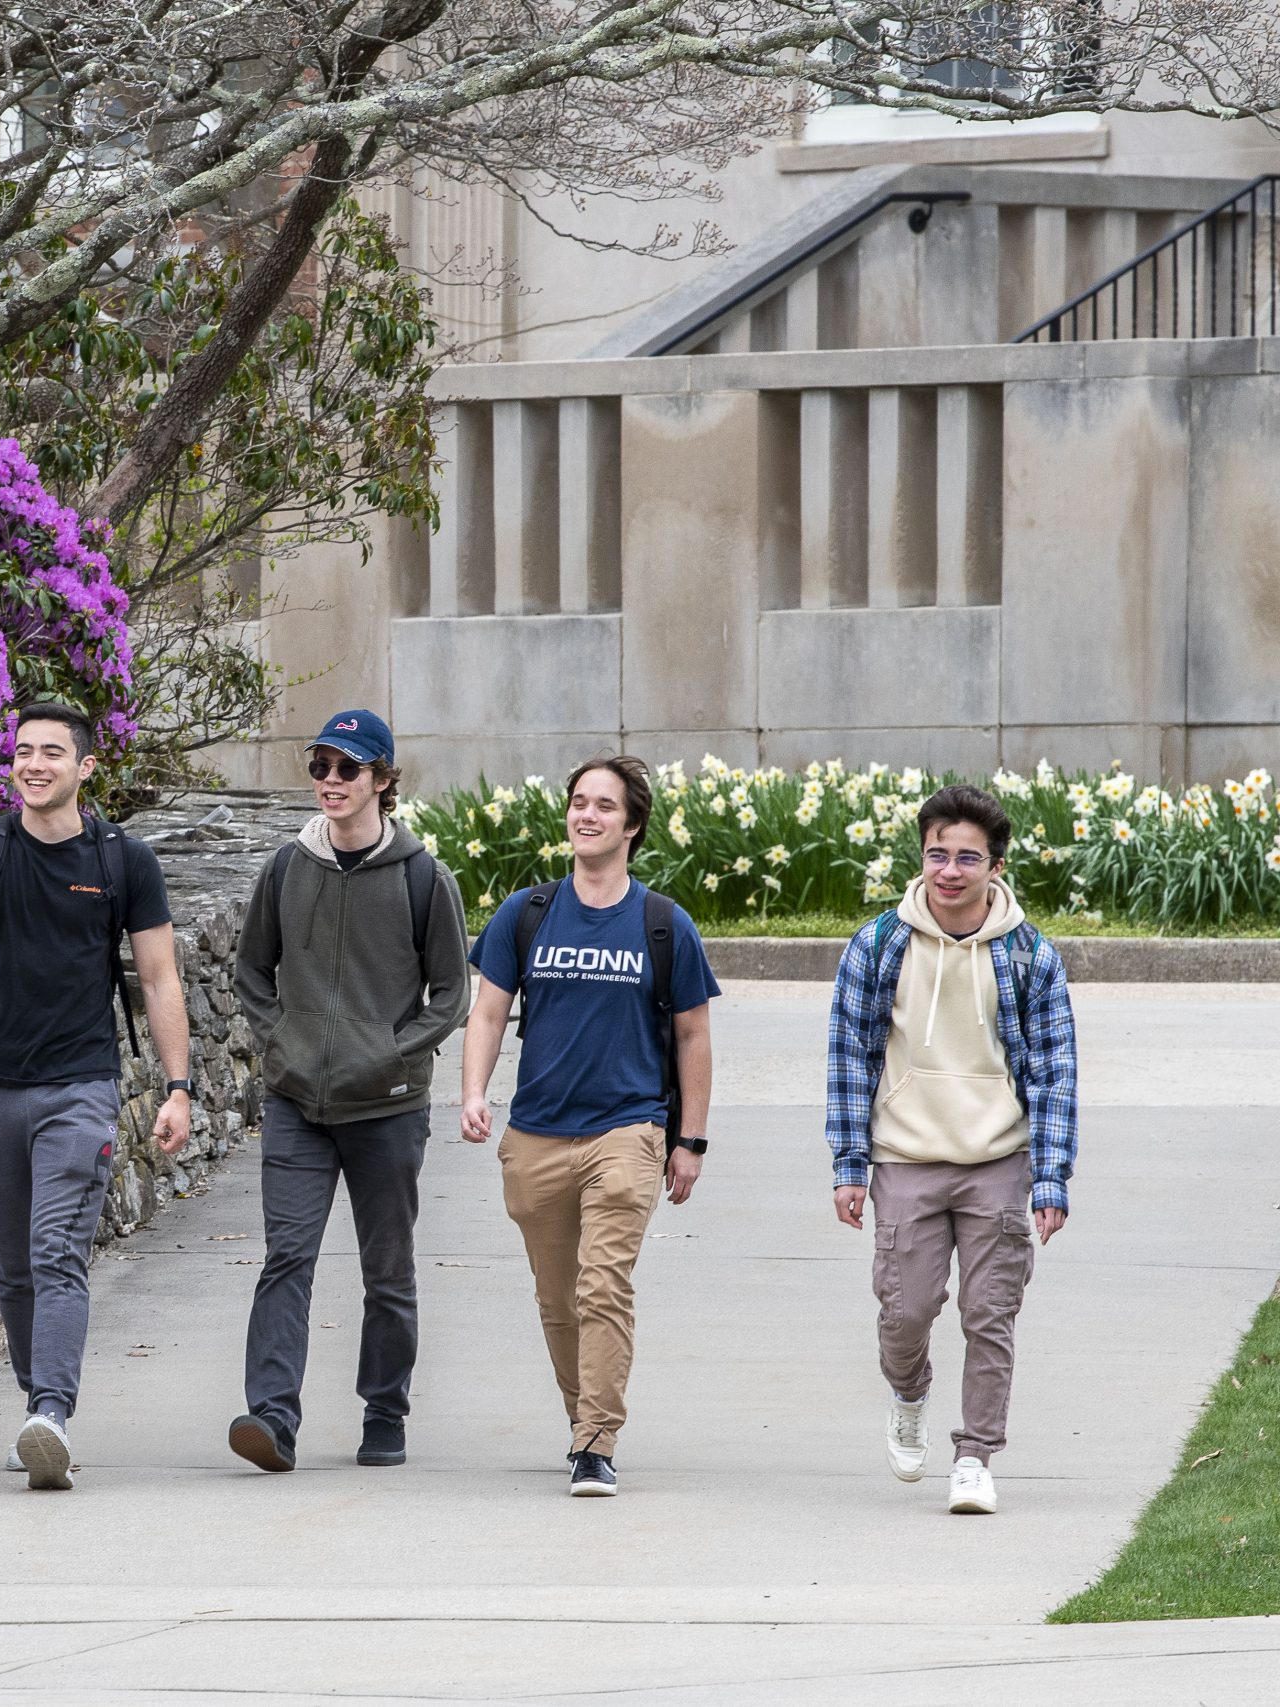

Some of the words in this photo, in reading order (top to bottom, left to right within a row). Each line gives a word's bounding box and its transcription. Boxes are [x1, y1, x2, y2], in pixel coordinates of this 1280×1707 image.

[75, 884, 101, 893] Columbia
[533, 946, 644, 974] UCONN
[532, 971, 564, 979] SCHOOL
[566, 971, 579, 979] OF
[581, 973, 641, 984] ENGINEERING
